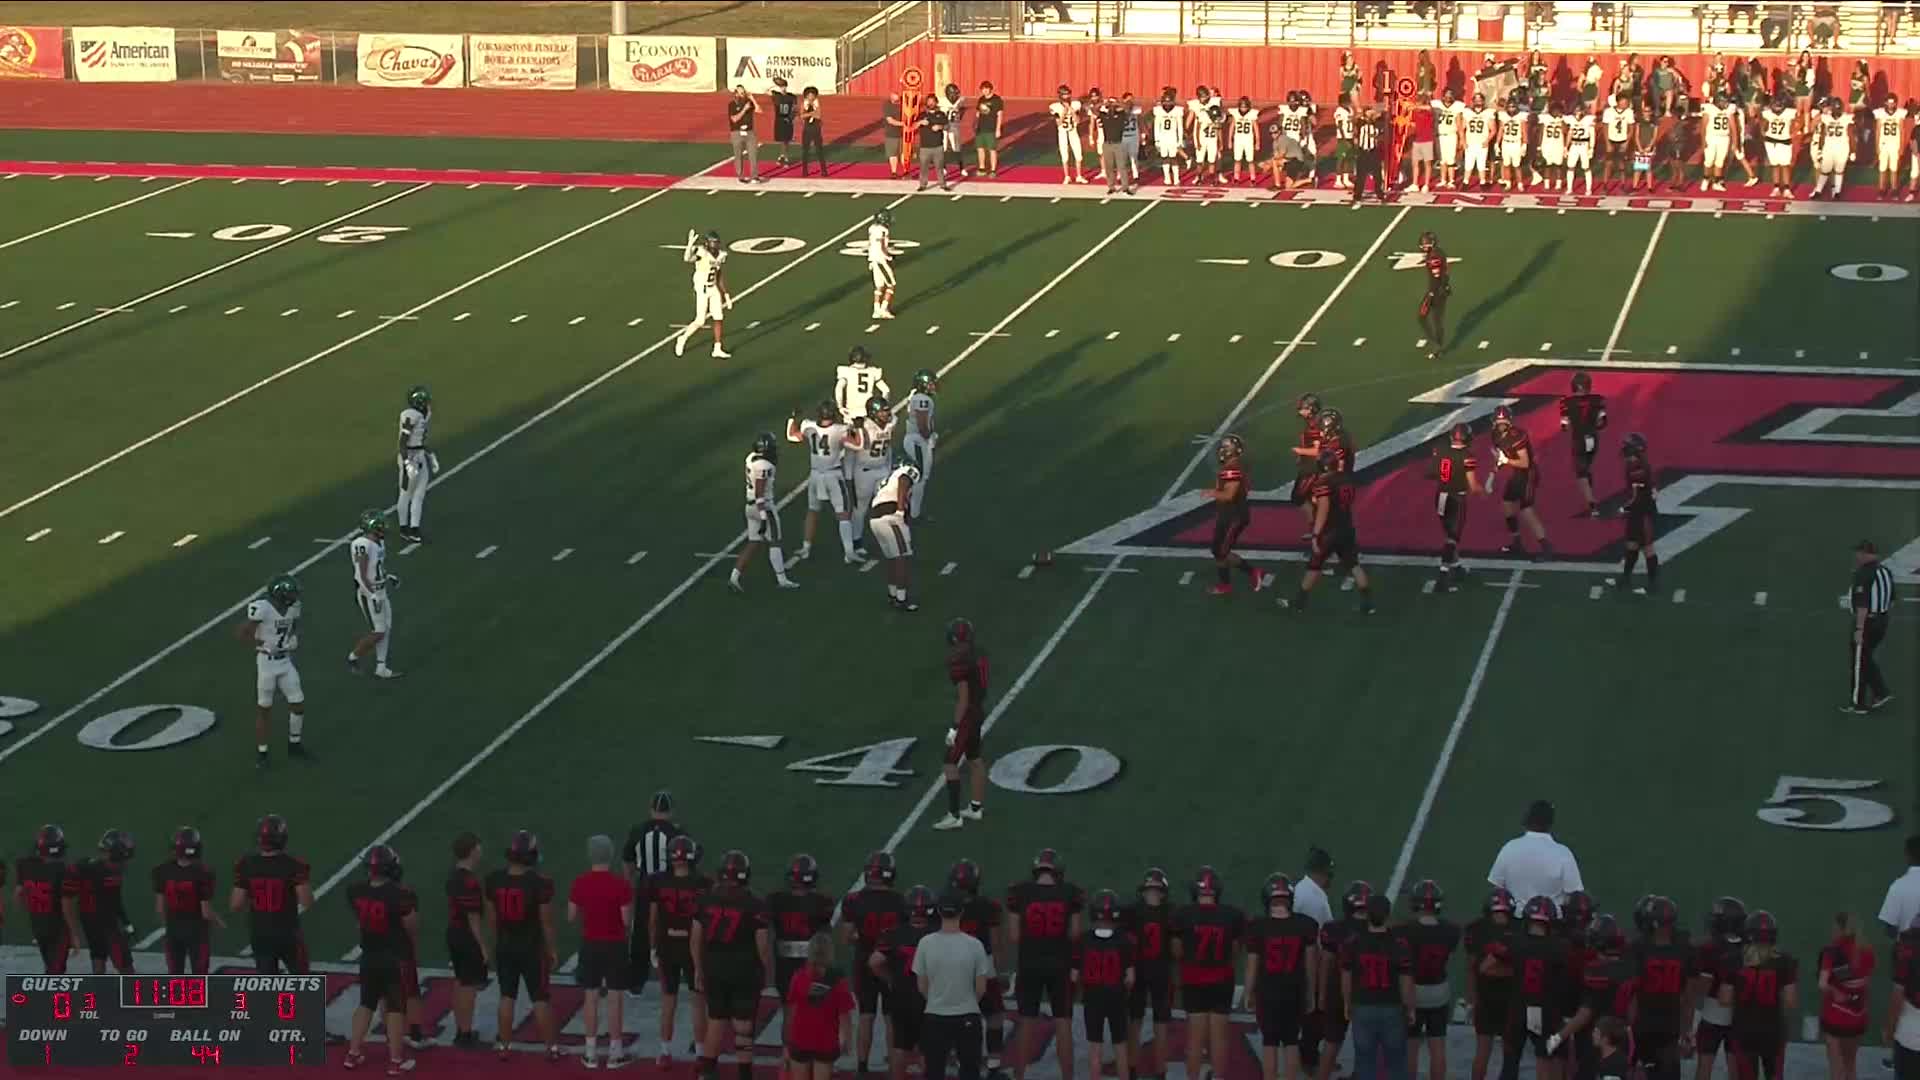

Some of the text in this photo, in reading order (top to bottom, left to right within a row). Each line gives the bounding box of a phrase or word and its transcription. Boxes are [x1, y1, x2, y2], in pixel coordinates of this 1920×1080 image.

[110, 41, 169, 58] American
[626, 41, 701, 63] ECONOMY
[380, 47, 437, 71] Chava's
[766, 56, 831, 68] ARMSTRONG
[766, 68, 794, 79] BANK
[1163, 119, 1171, 131] 8
[1236, 122, 1250, 134] 26
[1284, 118, 1300, 132] 29
[1469, 120, 1484, 134] 69
[1614, 119, 1623, 134] 4
[1714, 116, 1729, 130] 58
[857, 373, 869, 393] 5
[810, 433, 830, 455] 14
[1440, 458, 1452, 482] 9
[277, 627, 289, 649] 7
[1756, 775, 1894, 830] 5
[704, 904, 742, 943] 77
